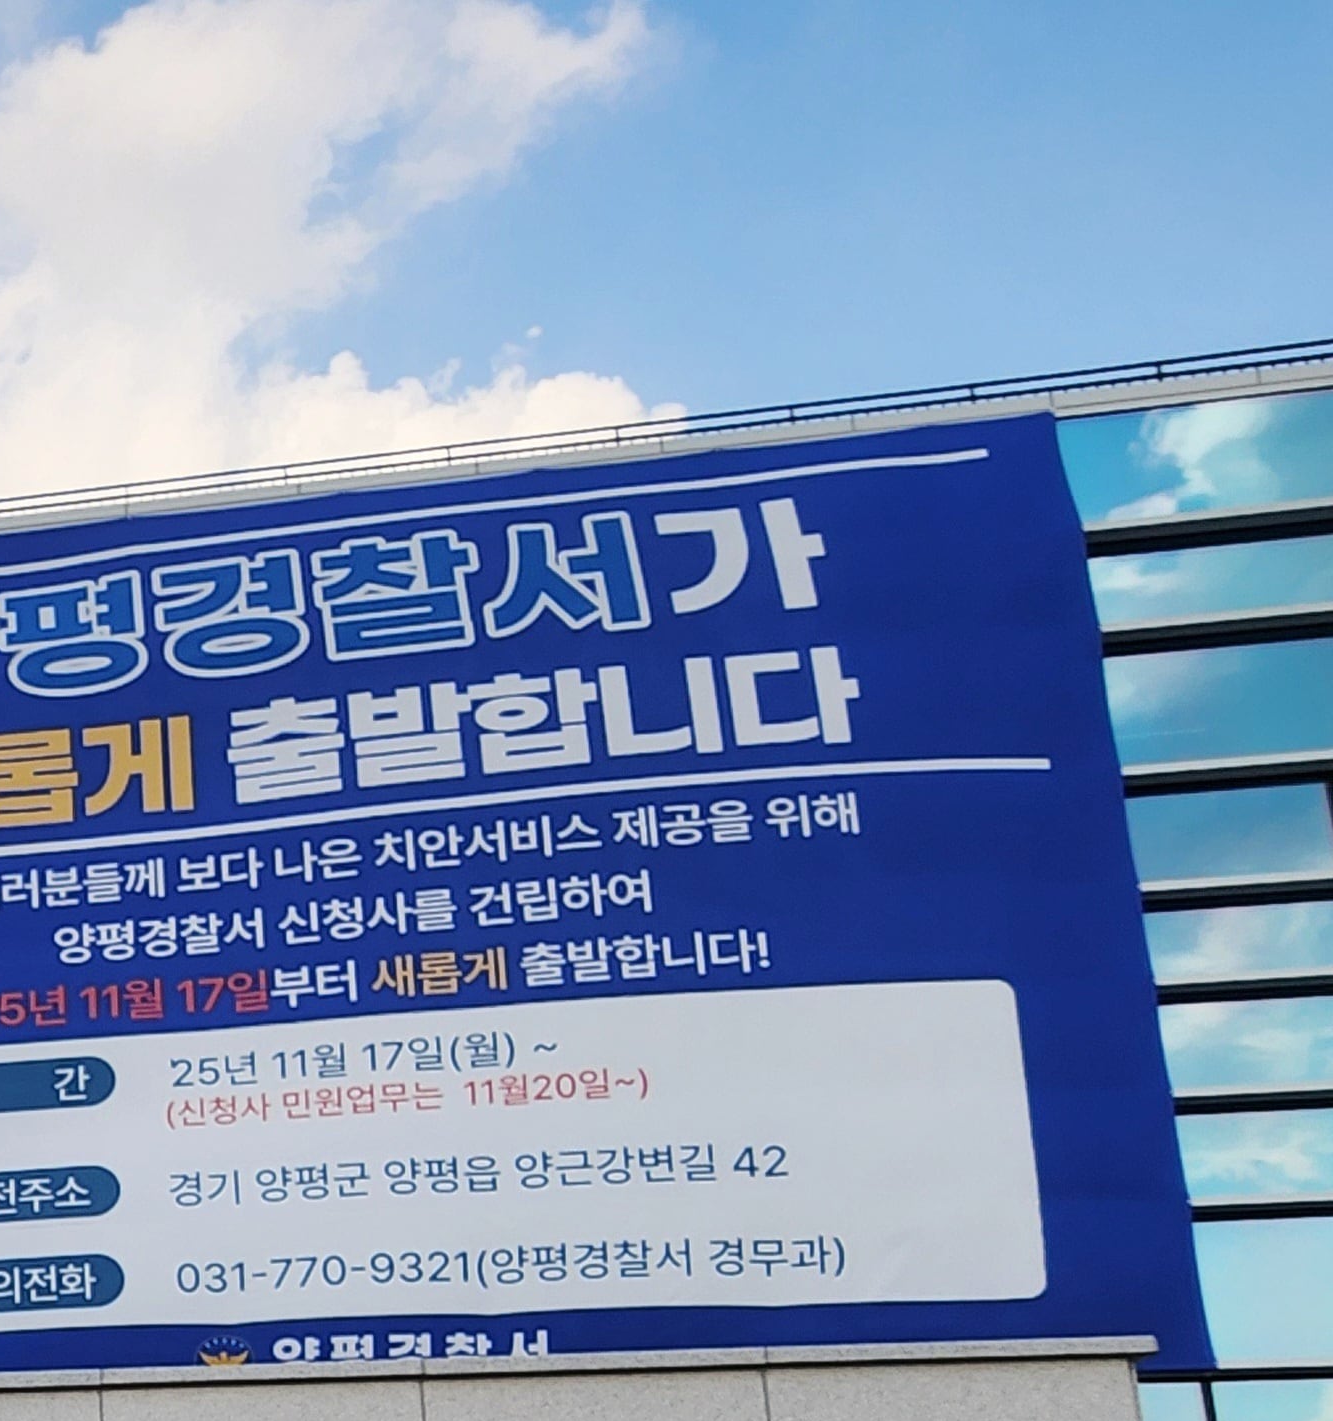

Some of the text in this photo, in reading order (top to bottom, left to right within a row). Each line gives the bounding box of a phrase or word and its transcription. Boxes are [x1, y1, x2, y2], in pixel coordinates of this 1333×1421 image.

[227, 645, 861, 805] 출발합니다
[177, 847, 264, 893] 보다
[273, 837, 364, 884] 나은
[373, 813, 602, 872] 치안서비스
[612, 798, 753, 849] 제공을
[765, 791, 861, 839] 위해
[53, 868, 653, 965] 양평경찰서 신청사를 건립하여
[78, 978, 164, 1021] 11월
[176, 958, 359, 1014] 17일부터
[371, 946, 508, 997] 새롭게
[520, 929, 772, 988] 출발합니다!
[272, 1042, 347, 1079] 11월
[362, 1031, 516, 1074] 17일(월)
[165, 1067, 650, 1130] (신청사 민원업무는 11월20일~)
[169, 1143, 789, 1207] 경기 양평군 양평읍 양근강변길 42
[176, 1235, 847, 1294] 031-770-9321(양평경찰서 경무과)
